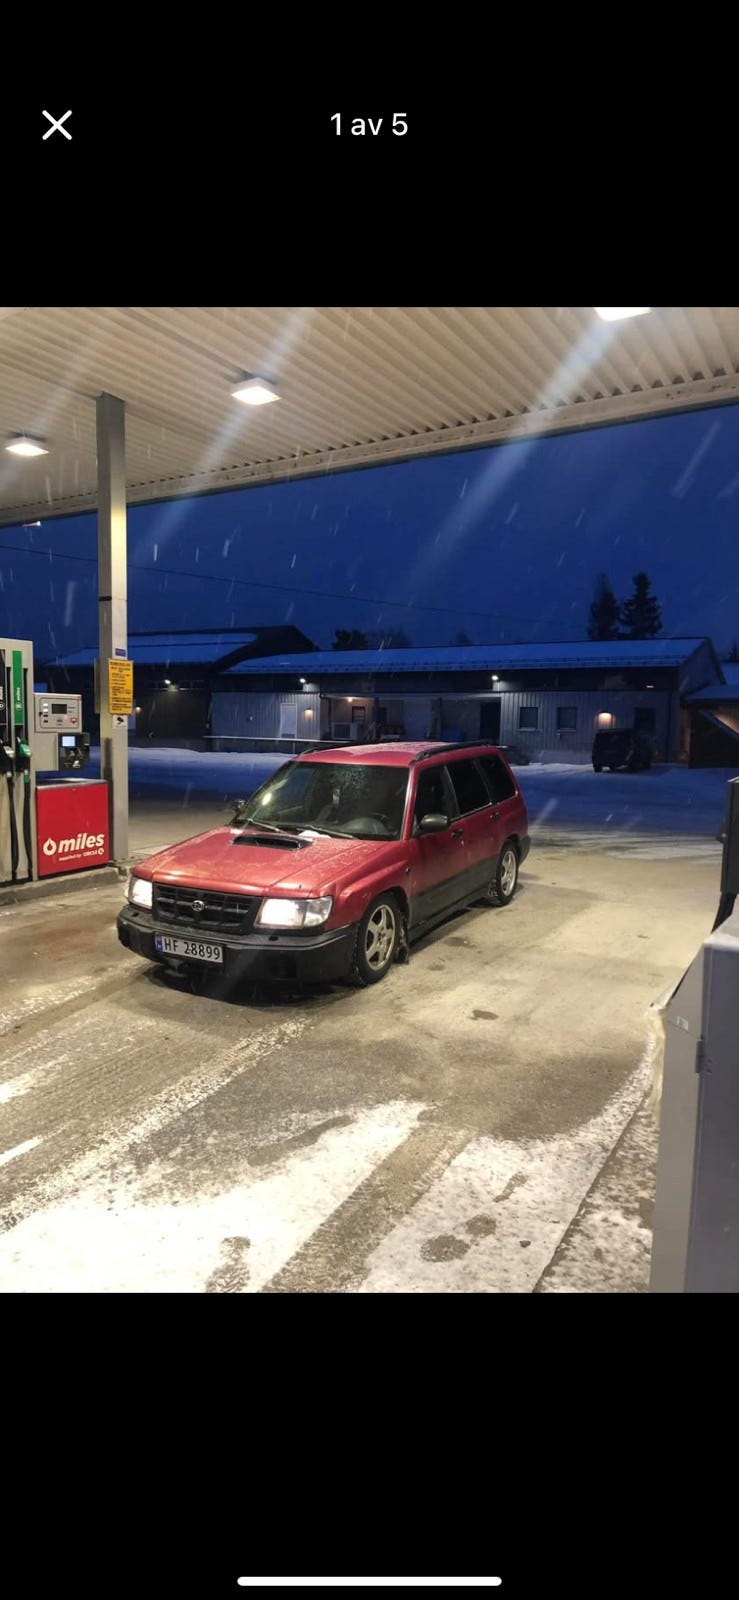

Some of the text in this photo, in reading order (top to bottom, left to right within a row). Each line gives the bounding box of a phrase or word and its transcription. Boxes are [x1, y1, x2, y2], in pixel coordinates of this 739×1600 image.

[57, 832, 105, 854] miles
[163, 936, 220, 960] HF 28899
